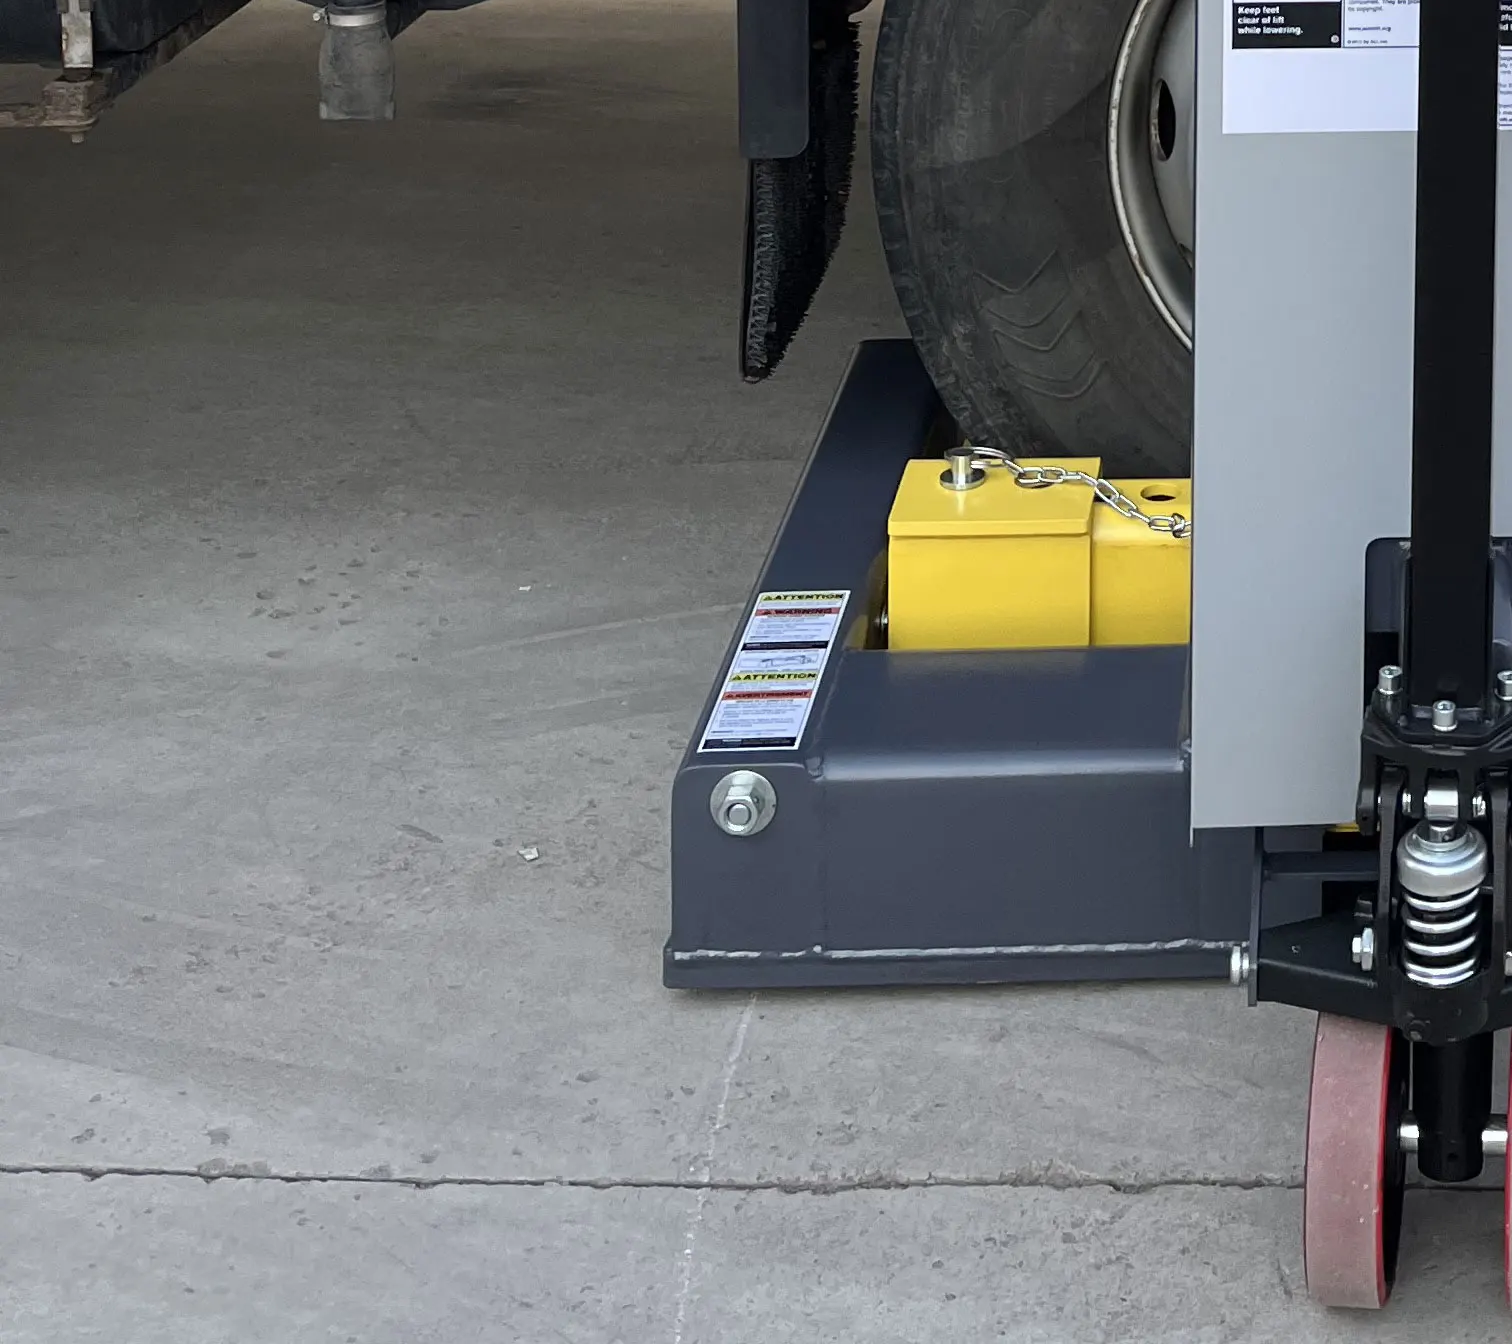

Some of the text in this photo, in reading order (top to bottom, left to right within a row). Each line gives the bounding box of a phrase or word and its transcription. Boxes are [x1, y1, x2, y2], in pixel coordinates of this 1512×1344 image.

[1238, 6, 1279, 16] Keep feet
[1238, 26, 1303, 36] while lowering.
